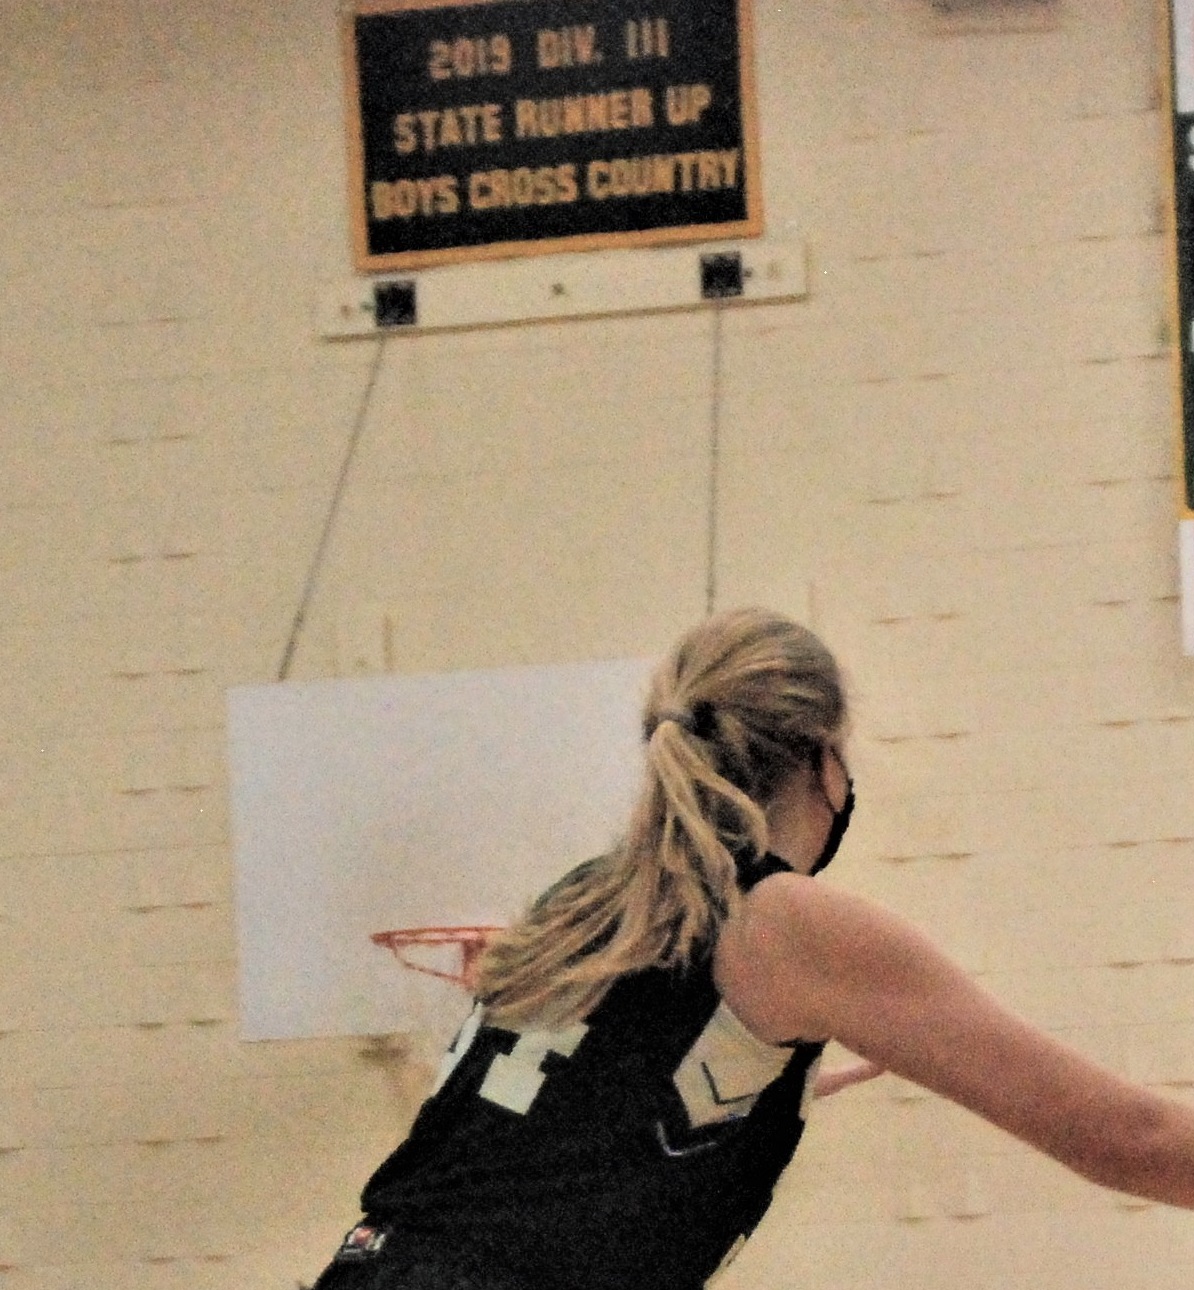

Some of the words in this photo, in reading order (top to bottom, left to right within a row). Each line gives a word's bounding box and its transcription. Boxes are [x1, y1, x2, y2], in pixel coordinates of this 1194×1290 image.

[428, 33, 512, 81] 2019
[394, 104, 502, 155] STATE
[515, 87, 654, 139] RUNNER
[665, 83, 712, 126] UP
[370, 175, 460, 220] BOYS
[469, 163, 580, 210] CROSS
[588, 147, 741, 199] COUNTRY
